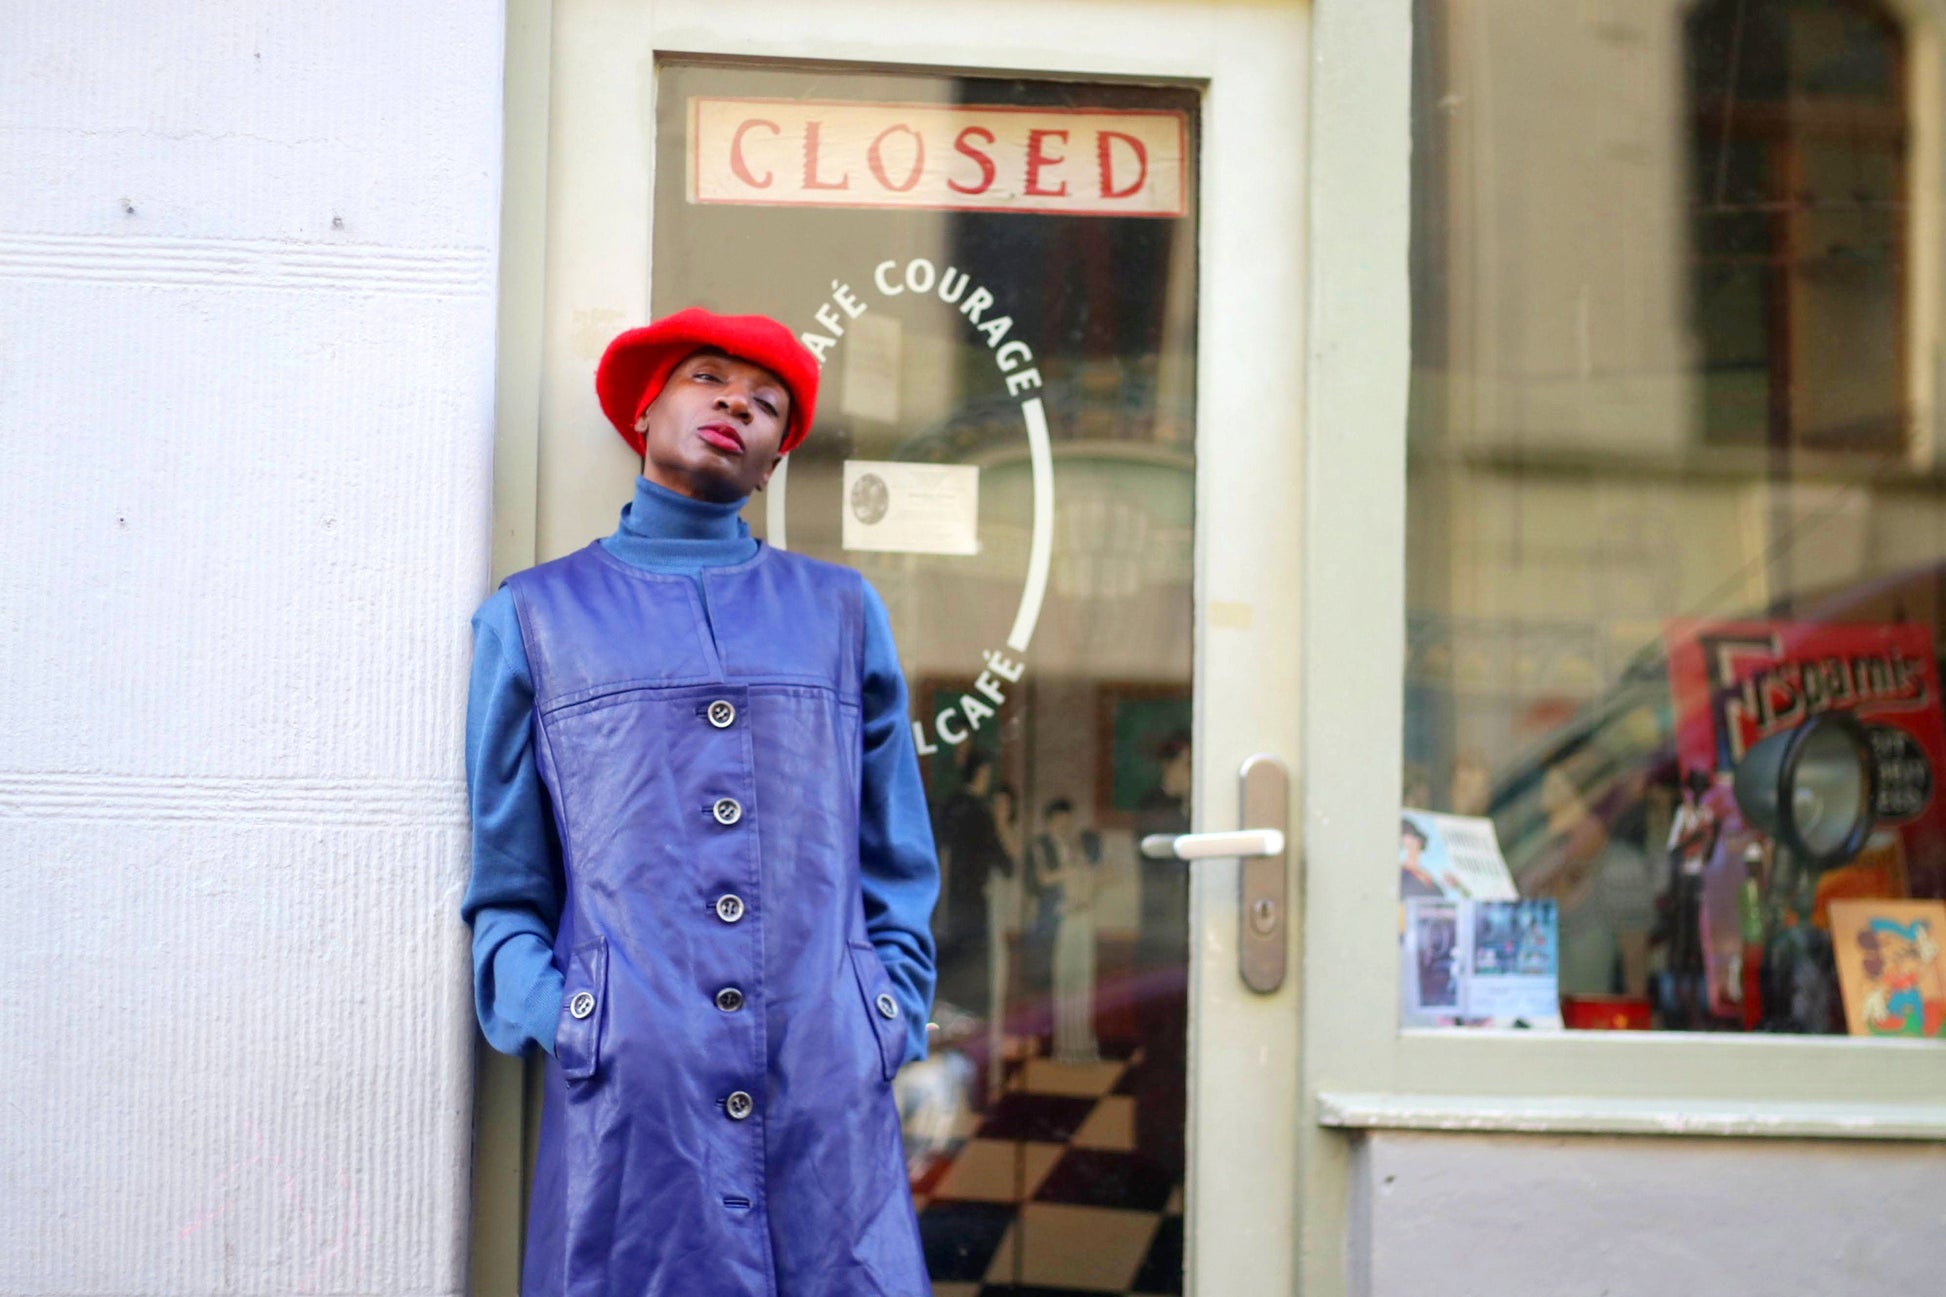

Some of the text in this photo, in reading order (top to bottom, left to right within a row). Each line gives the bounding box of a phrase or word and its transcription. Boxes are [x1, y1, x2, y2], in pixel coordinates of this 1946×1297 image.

[730, 118, 1149, 199] CLOSED
[799, 257, 1043, 398] AFÉ COURAGE
[911, 648, 1026, 757] LCAFÉ
